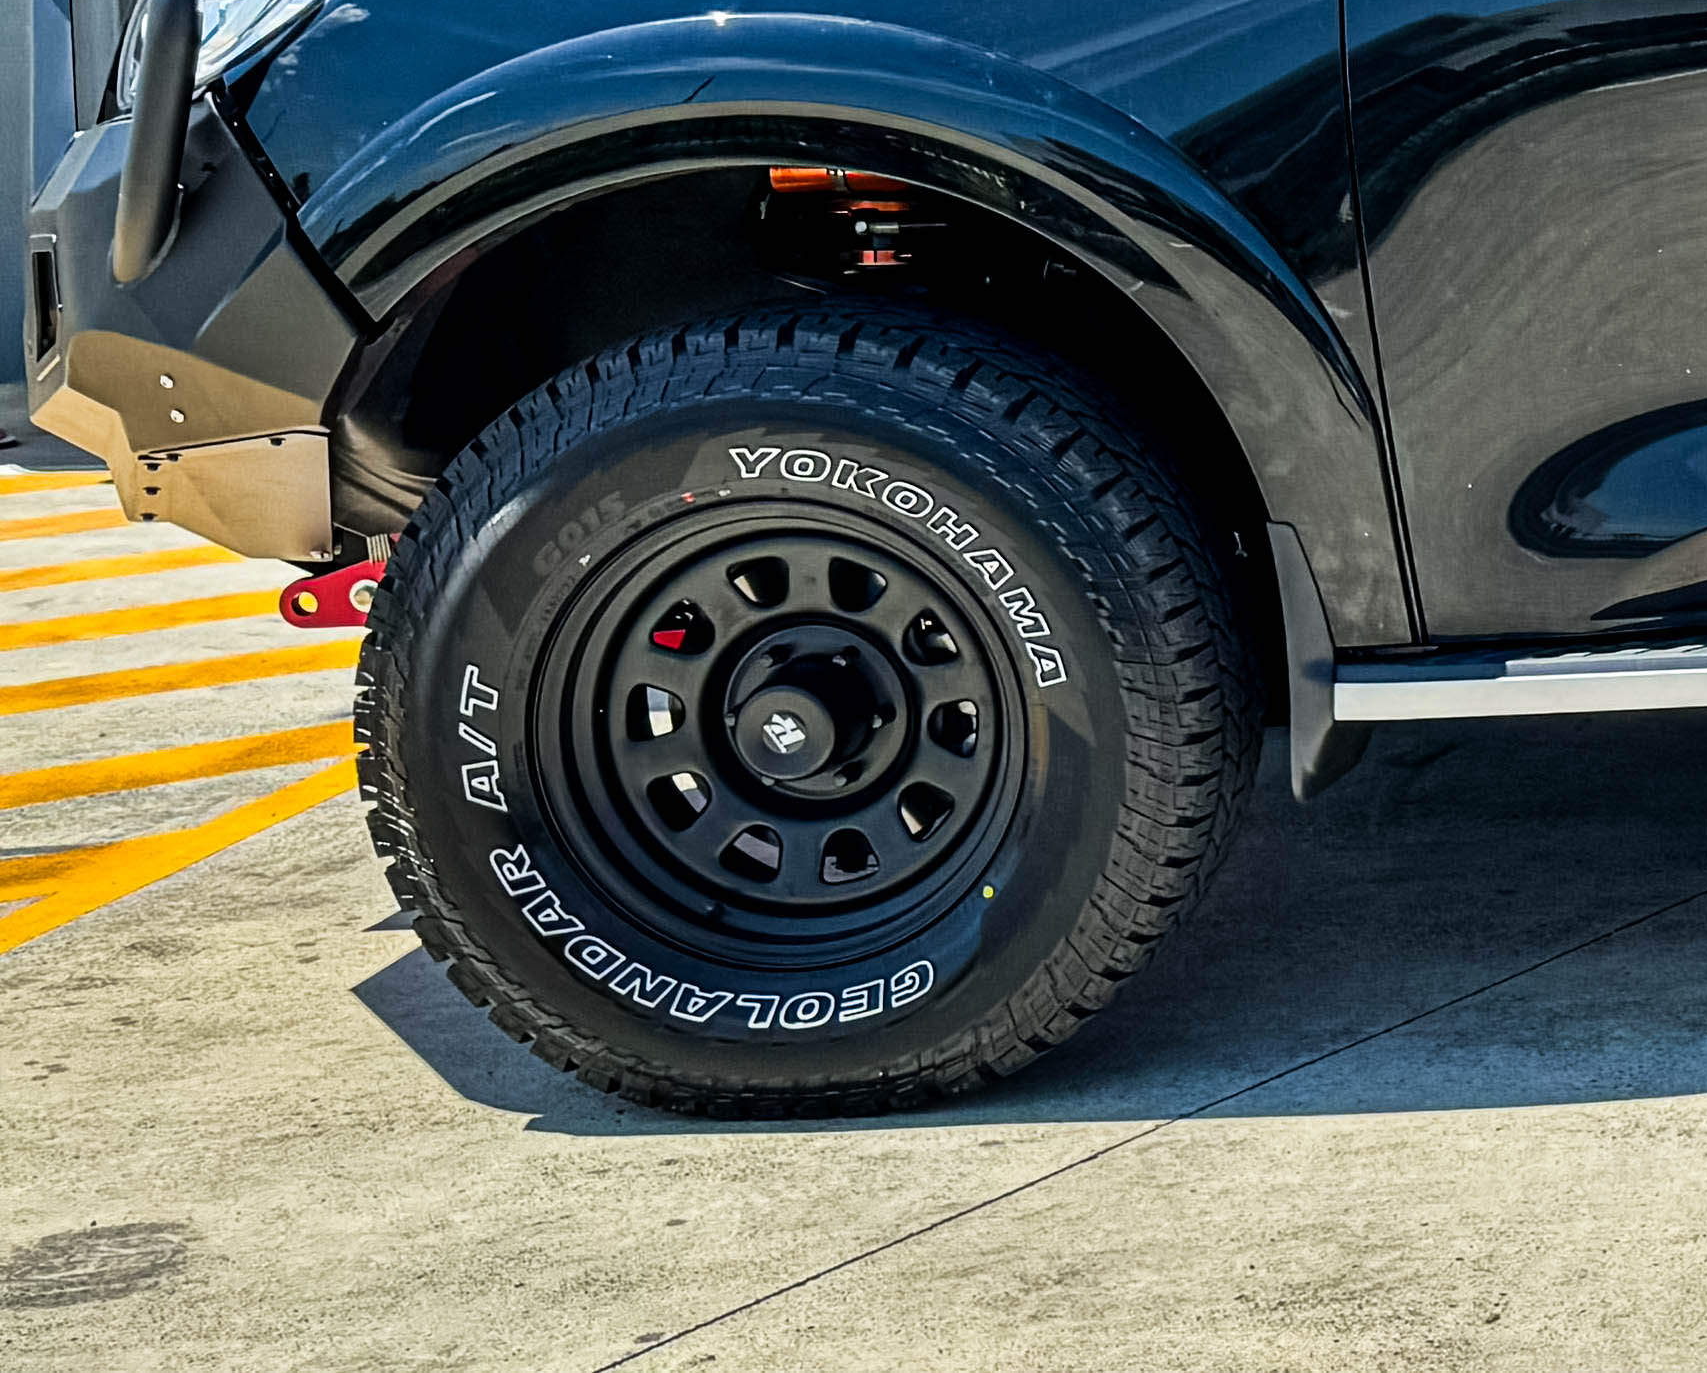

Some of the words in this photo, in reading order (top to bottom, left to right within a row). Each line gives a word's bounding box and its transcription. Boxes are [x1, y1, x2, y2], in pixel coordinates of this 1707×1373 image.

[728, 447, 1067, 688] YOKOHAMA
[458, 664, 508, 813] A/T
[489, 843, 935, 1030] GEOLANDAR
